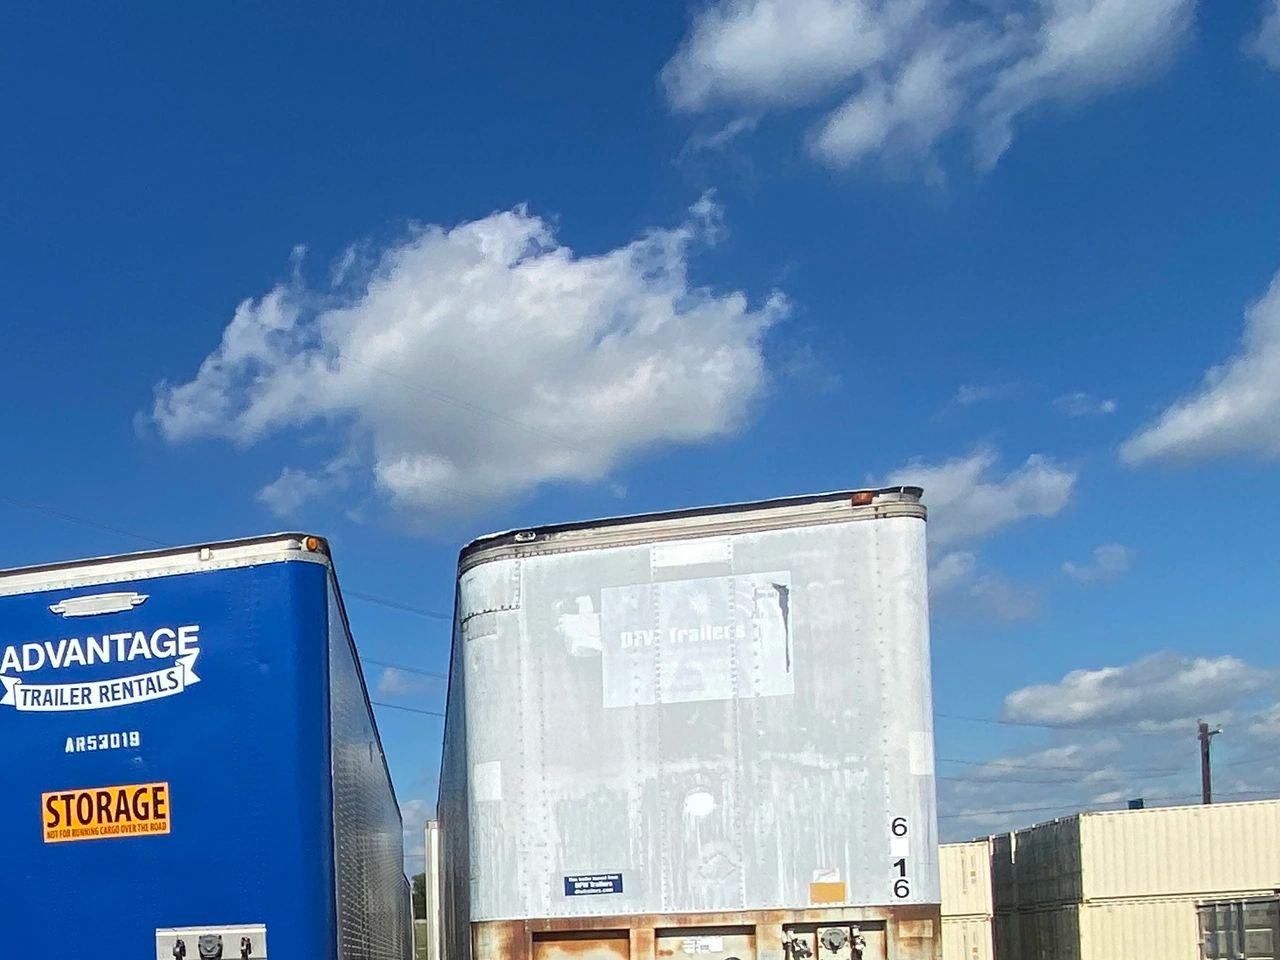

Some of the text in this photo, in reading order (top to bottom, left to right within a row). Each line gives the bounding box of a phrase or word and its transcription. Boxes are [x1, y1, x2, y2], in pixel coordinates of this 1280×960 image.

[0, 625, 200, 674] ADVANTAGE
[20, 670, 179, 706] TRAILER RENTALS
[46, 786, 167, 828] STORAGE
